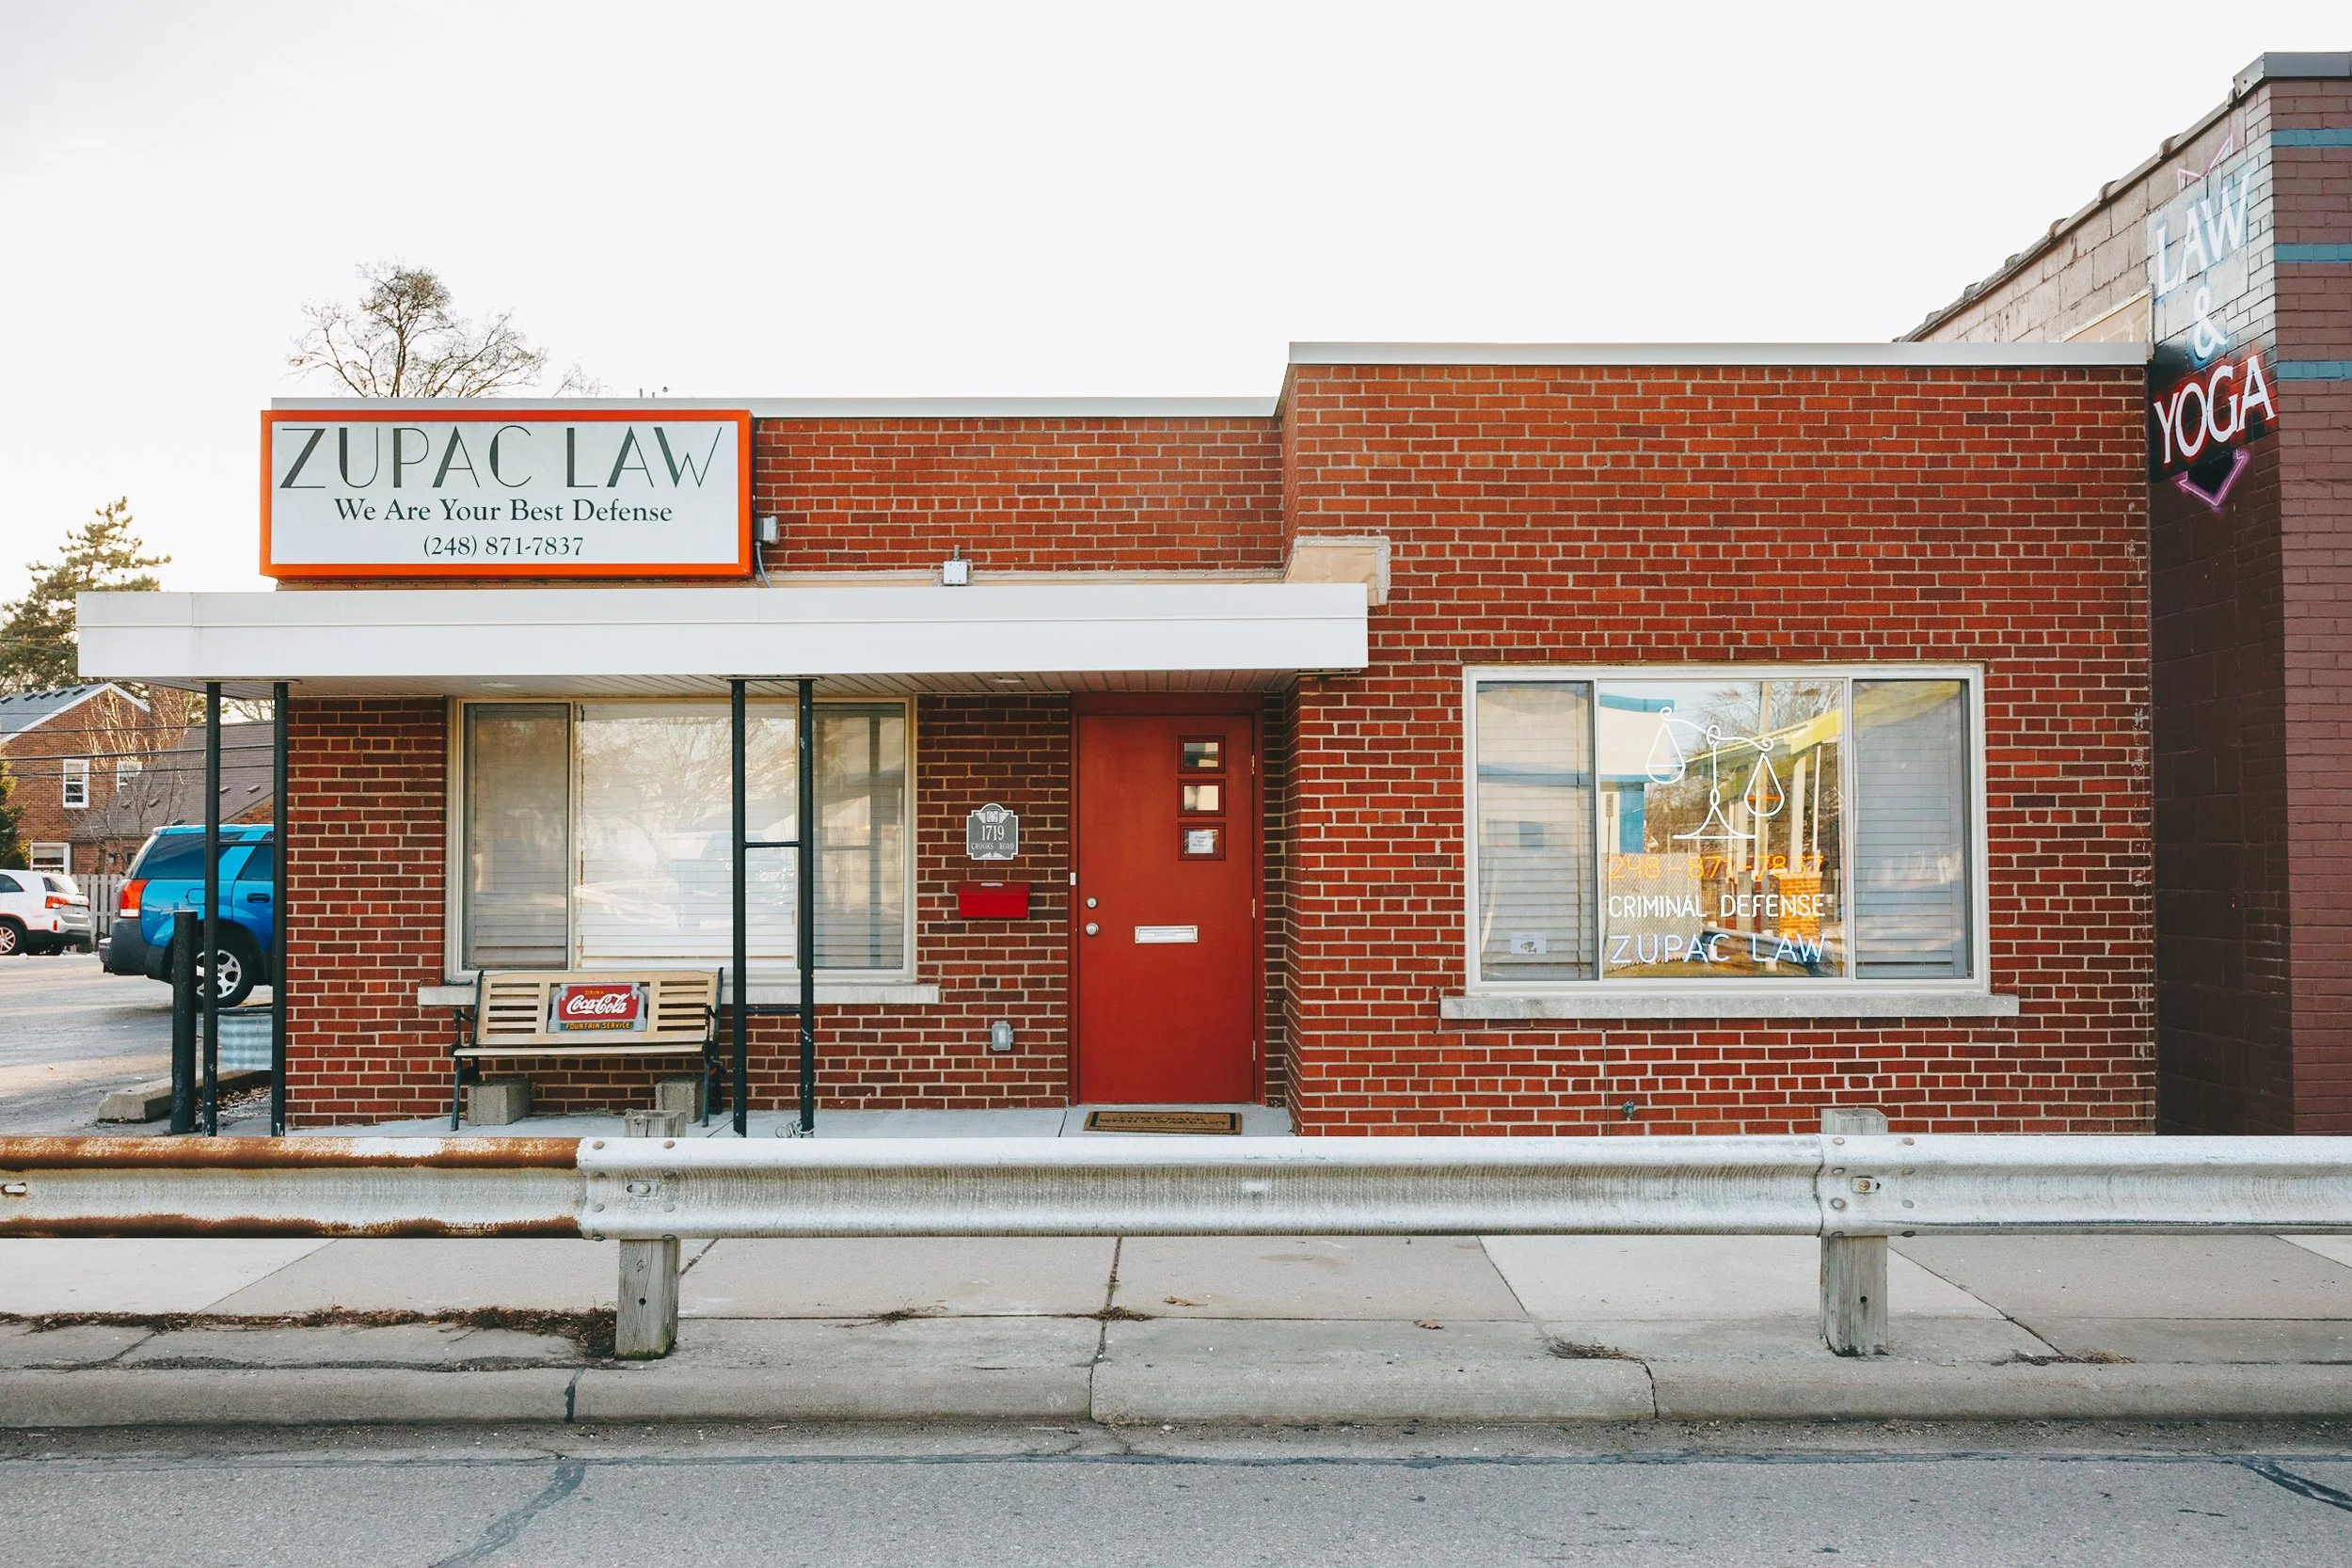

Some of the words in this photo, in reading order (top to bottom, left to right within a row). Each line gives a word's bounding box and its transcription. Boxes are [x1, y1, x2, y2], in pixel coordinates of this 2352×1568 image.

[2155, 174, 2250, 298] LAW
[2193, 285, 2229, 359] &
[2153, 356, 2276, 465] YOGA
[279, 425, 532, 489] ZUPAC
[566, 425, 723, 488] LAW
[334, 498, 376, 521] We
[384, 498, 431, 521] Are
[438, 498, 501, 521] Your
[510, 498, 564, 521] Best
[573, 498, 673, 521] Defense
[423, 535, 478, 558] (248)
[485, 535, 584, 557] 871-7837
[981, 825, 1005, 841] 1719
[1608, 895, 1708, 918] CRIMINAL
[1720, 894, 1826, 918] DEFENSE
[1609, 933, 1730, 963] ZUPAC
[1752, 933, 1826, 963] LAW
[566, 993, 630, 1015] Coca-Cola
